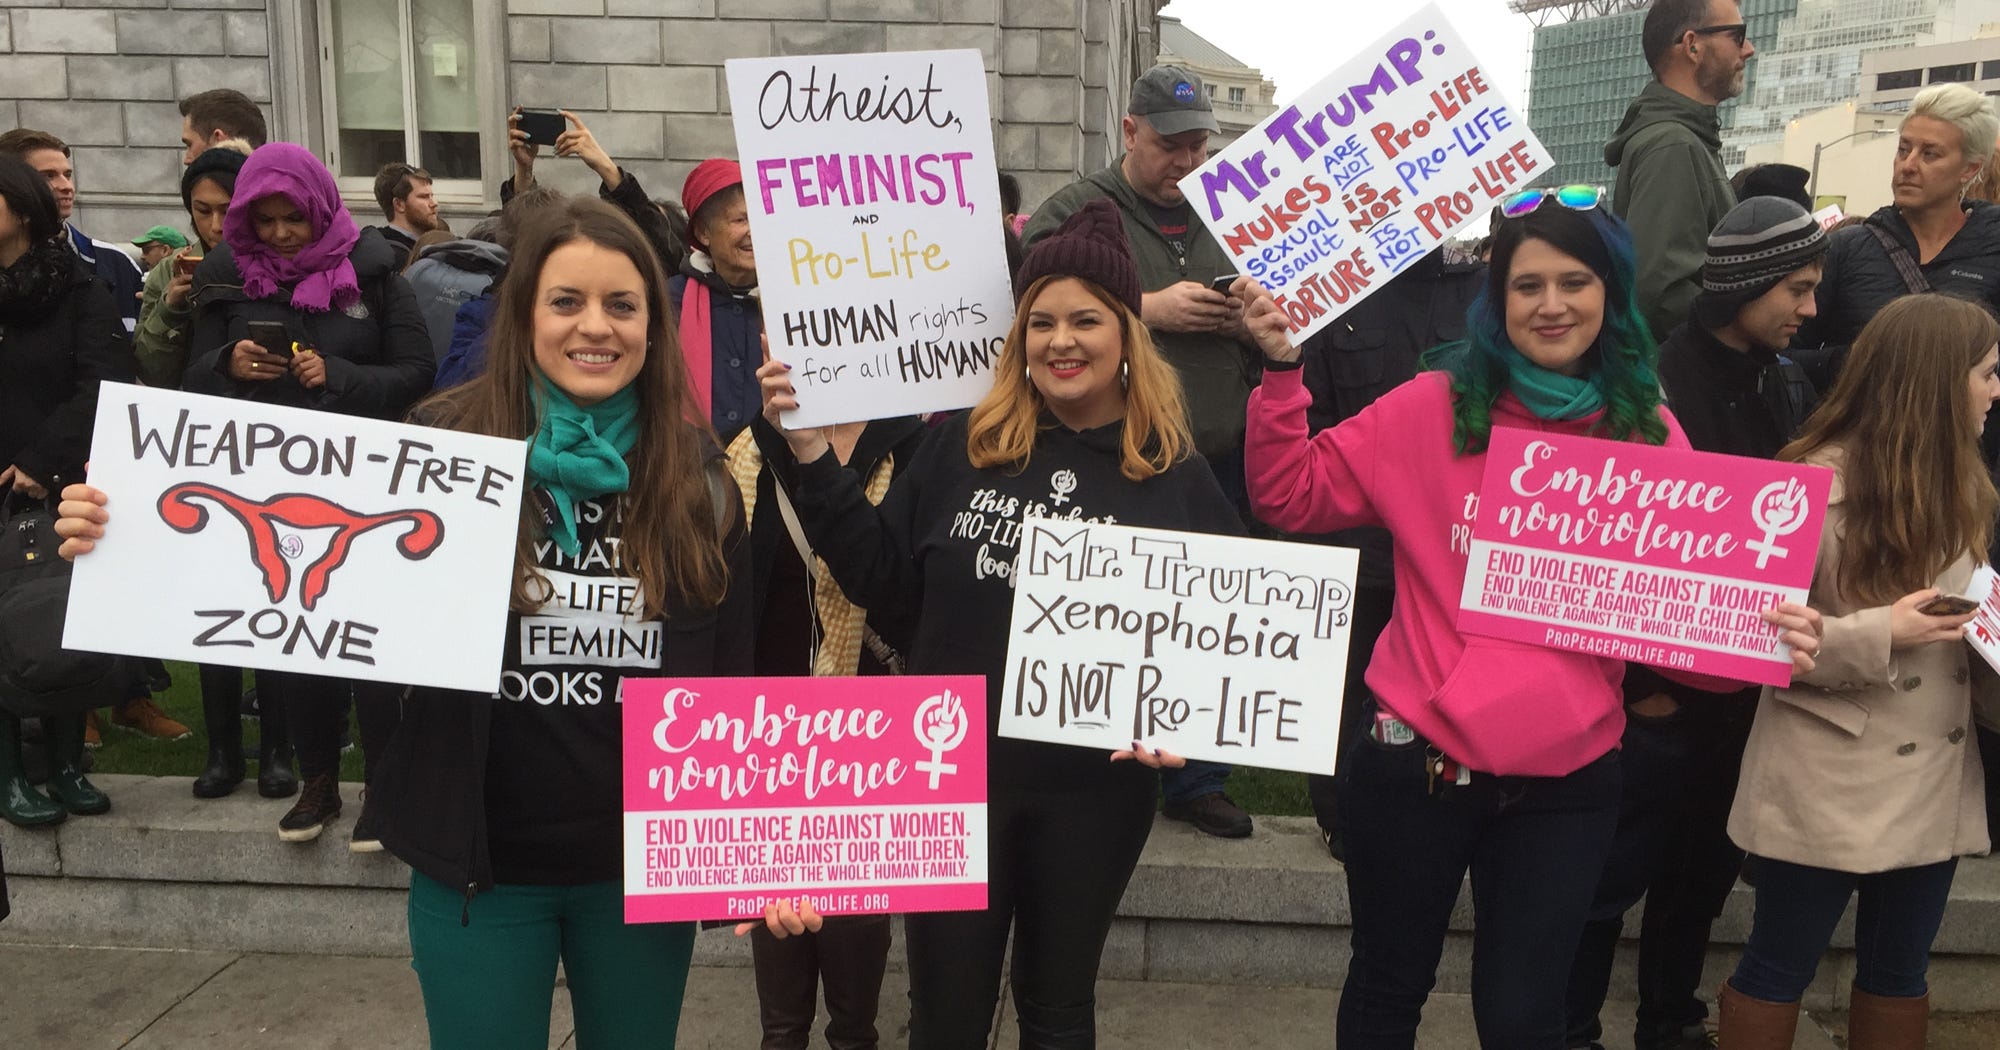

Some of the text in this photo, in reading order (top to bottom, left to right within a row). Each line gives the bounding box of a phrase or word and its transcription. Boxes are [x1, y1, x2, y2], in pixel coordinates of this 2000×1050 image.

[1323, 134, 1361, 174] ARE
[1333, 147, 1371, 187] NOT
[756, 152, 974, 216] FEMINIST,
[1200, 150, 1280, 222] Mr.
[852, 214, 879, 225] AND
[1349, 186, 1402, 233] NOT
[788, 229, 950, 286] Pro-Life
[1247, 208, 1339, 277] sexual
[1259, 233, 1344, 290] assault
[1272, 140, 1538, 335] TORTURE IS NOT PRO-LIFE
[1957, 270, 1984, 281] Columbia
[783, 297, 987, 347] HUMAN rights
[802, 358, 847, 387] for
[860, 354, 890, 378] all
[1509, 440, 1732, 514] Embrace
[969, 489, 1019, 518] this
[1023, 500, 1047, 518] is
[950, 512, 1023, 549] PRO-LIF
[1498, 501, 1739, 564] nonviolence
[524, 575, 637, 617] O-LIFE
[1029, 525, 1352, 640] Mr. Trump,
[1483, 574, 1514, 595] END
[1518, 579, 1591, 607] VIOLENCE
[1592, 592, 1661, 618] AGAINST
[1663, 602, 1695, 624] OUR
[1487, 550, 1525, 576] END
[1530, 555, 1618, 591] VIOLENCE
[1621, 570, 1706, 604] AGAINST
[192, 608, 379, 665] ZONE
[529, 625, 659, 660] FEMINI
[1481, 592, 1778, 656] END VIOLENCE AGAINST THE WHOLE HUMAN FAMILY.
[492, 670, 603, 706] OOKS
[1014, 656, 1047, 718] IS
[1059, 661, 1125, 728] NOT
[652, 687, 892, 754] Embrace
[648, 745, 907, 802] nonviolence
[646, 811, 971, 845] END VIOLENCE AGAINST WOMEN.
[646, 839, 969, 870] END VIOLENCE AGAINST OUR CHILDREN.
[646, 860, 968, 888] END VIOLENCE AGAINST THE WHOLE HUMAN FAMILY.
